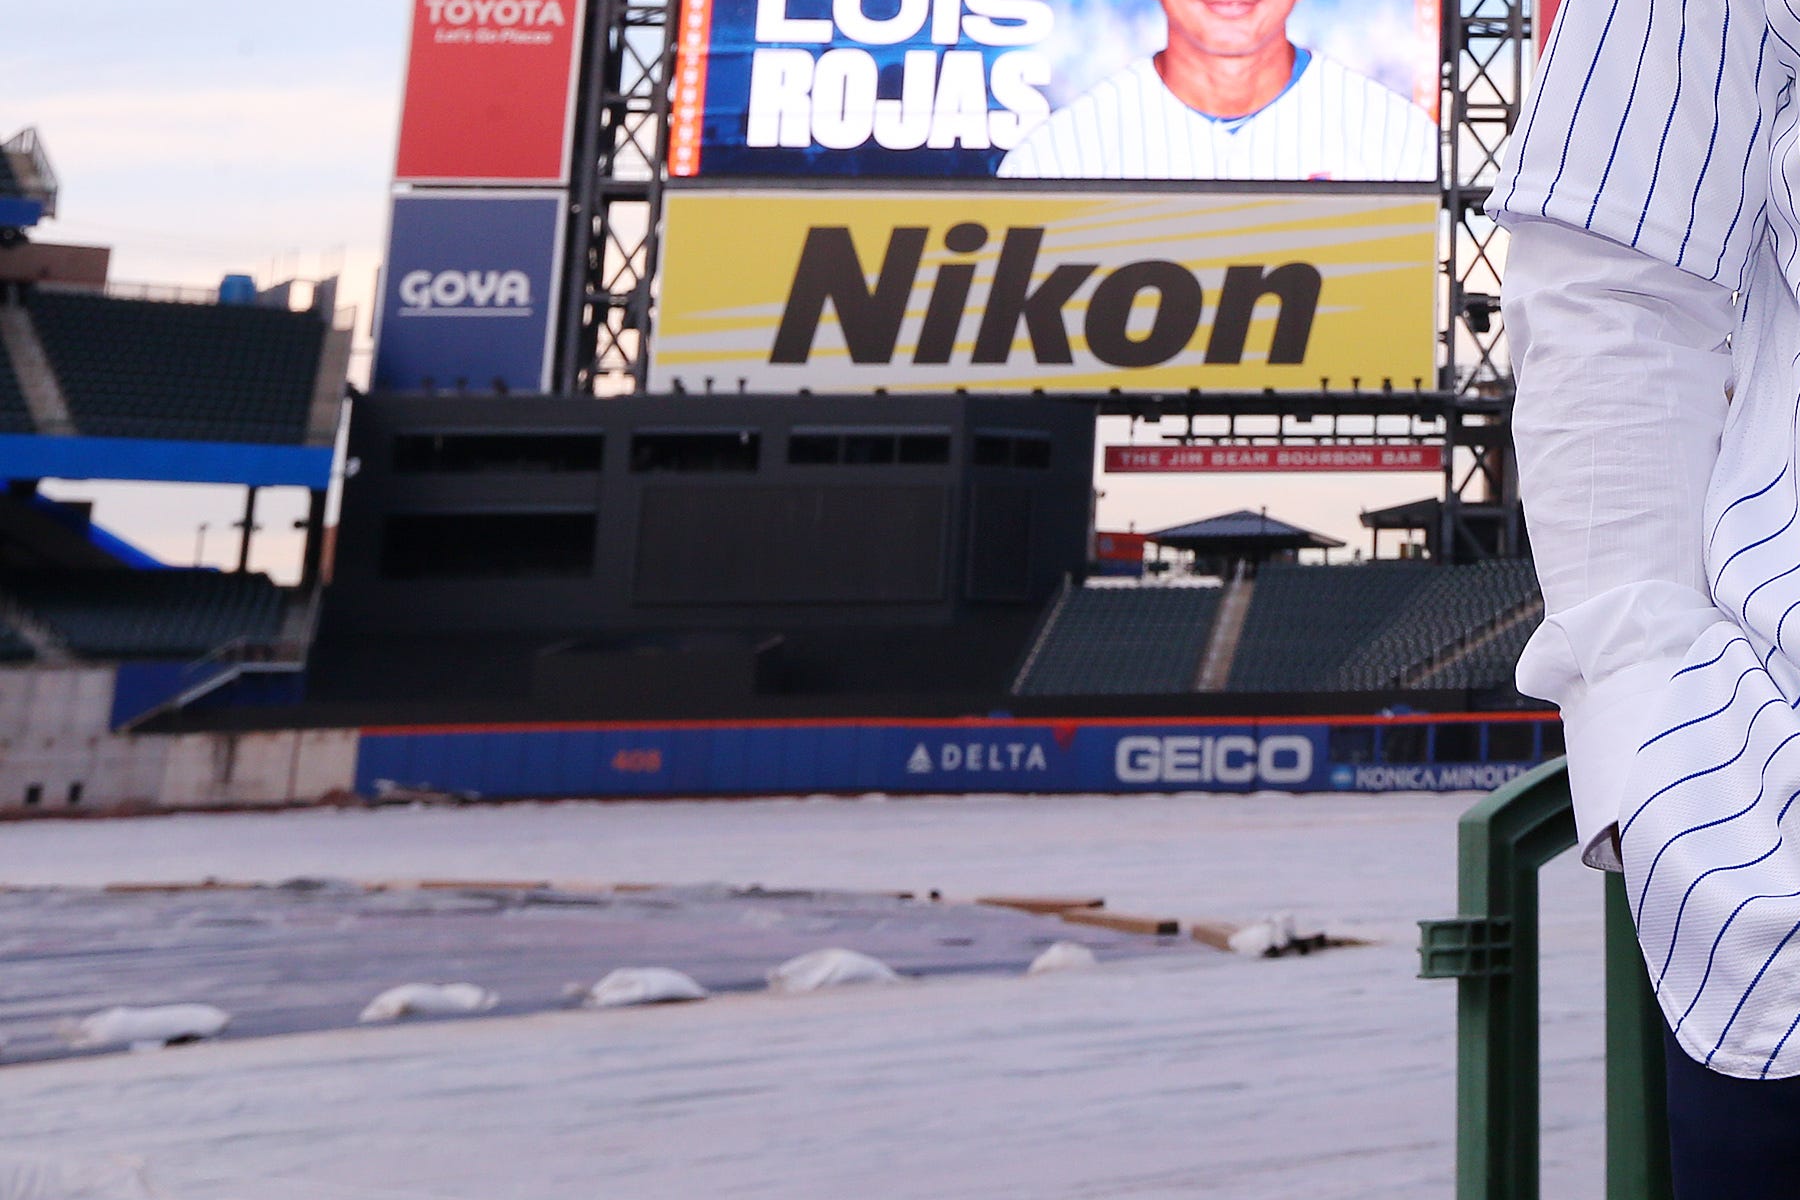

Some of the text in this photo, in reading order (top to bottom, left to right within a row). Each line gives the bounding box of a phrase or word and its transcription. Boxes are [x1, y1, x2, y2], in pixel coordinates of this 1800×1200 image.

[747, 48, 1053, 150] ROJAS
[399, 270, 531, 310] GOYA
[769, 222, 1323, 368] Nikon
[1121, 451, 1422, 466] THE JIM BEAM BOURBON BAR
[941, 743, 1047, 772] DELTA
[1115, 735, 1313, 784] GEICO
[1356, 764, 1530, 789] KONICA MINOLT
